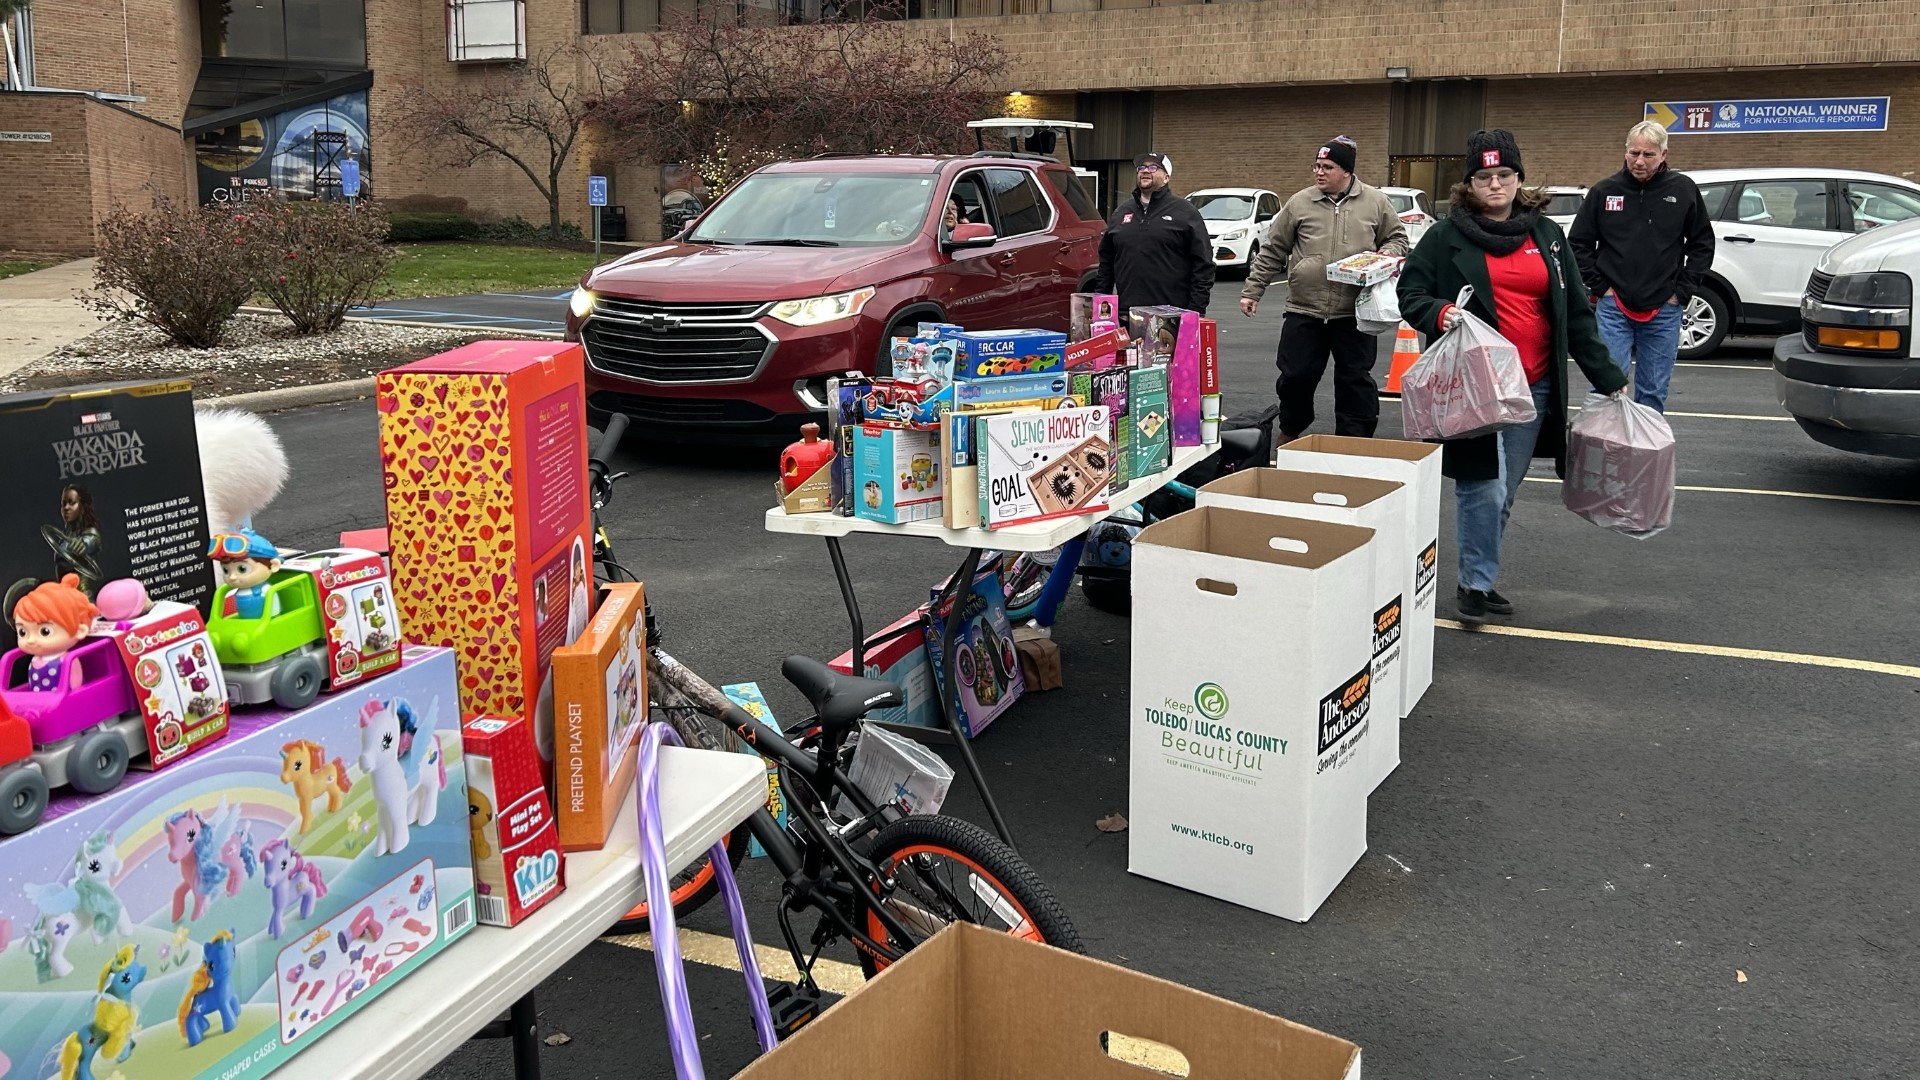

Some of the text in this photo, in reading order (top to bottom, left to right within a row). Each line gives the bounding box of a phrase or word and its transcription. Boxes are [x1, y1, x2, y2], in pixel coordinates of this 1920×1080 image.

[1688, 113, 1704, 128] 11
[1744, 104, 1878, 116] NATIONAL WINNER
[983, 343, 994, 352] RC
[996, 342, 1014, 352] CAR
[1068, 348, 1089, 360] CATCH
[73, 420, 120, 436] BLACK PANTHER
[1011, 418, 1044, 448] SLING
[1048, 414, 1089, 443] HOCKEY
[52, 430, 144, 460] WAKANDA
[58, 447, 147, 480] FOREVER
[978, 450, 988, 499] SLING HOCKEY
[992, 473, 1025, 505] GOAL
[125, 496, 190, 517] THE FORMER WAR DOG
[126, 520, 139, 529] HAS
[141, 514, 163, 526] STAYED
[164, 511, 179, 520] TRUE
[188, 506, 199, 514] HER
[128, 518, 199, 541] WORD AFTER THE EVENTS
[129, 544, 138, 553] OF
[140, 539, 160, 550] BLACK
[161, 532, 187, 545] PANTHER
[131, 552, 158, 565] HELPING
[159, 547, 178, 557] THOSE
[186, 540, 201, 550] NEED
[132, 563, 159, 576] OUTSIDE
[160, 561, 168, 569] OF
[154, 573, 170, 582] WILL
[170, 568, 185, 579] HAVE
[194, 562, 205, 571] PUT
[150, 583, 179, 596] POLITICAL
[178, 589, 194, 599] ASIDE
[332, 599, 339, 608] 4
[1373, 623, 1400, 654] dersons
[144, 665, 151, 676] 4
[362, 660, 378, 670] BUILD
[1164, 697, 1194, 715] Keep
[1322, 698, 1341, 725] The
[187, 727, 204, 742] BUILD
[212, 718, 223, 729] CAR
[1320, 693, 1370, 748] Andersons
[1161, 730, 1262, 771] Beautiful
[1236, 730, 1288, 755] COUNTY
[1317, 718, 1369, 774] Serving the community
[568, 702, 584, 812] PRETEND PLAYSET
[1180, 762, 1200, 772] AMERICA
[1232, 775, 1256, 786] AFFILIATE
[510, 800, 541, 826] Mini Pet
[511, 812, 542, 838] Play Set
[1171, 823, 1254, 855] www.ktlcb.org
[516, 852, 557, 896] KID
[222, 1038, 276, 1080] SHAPED CASES
